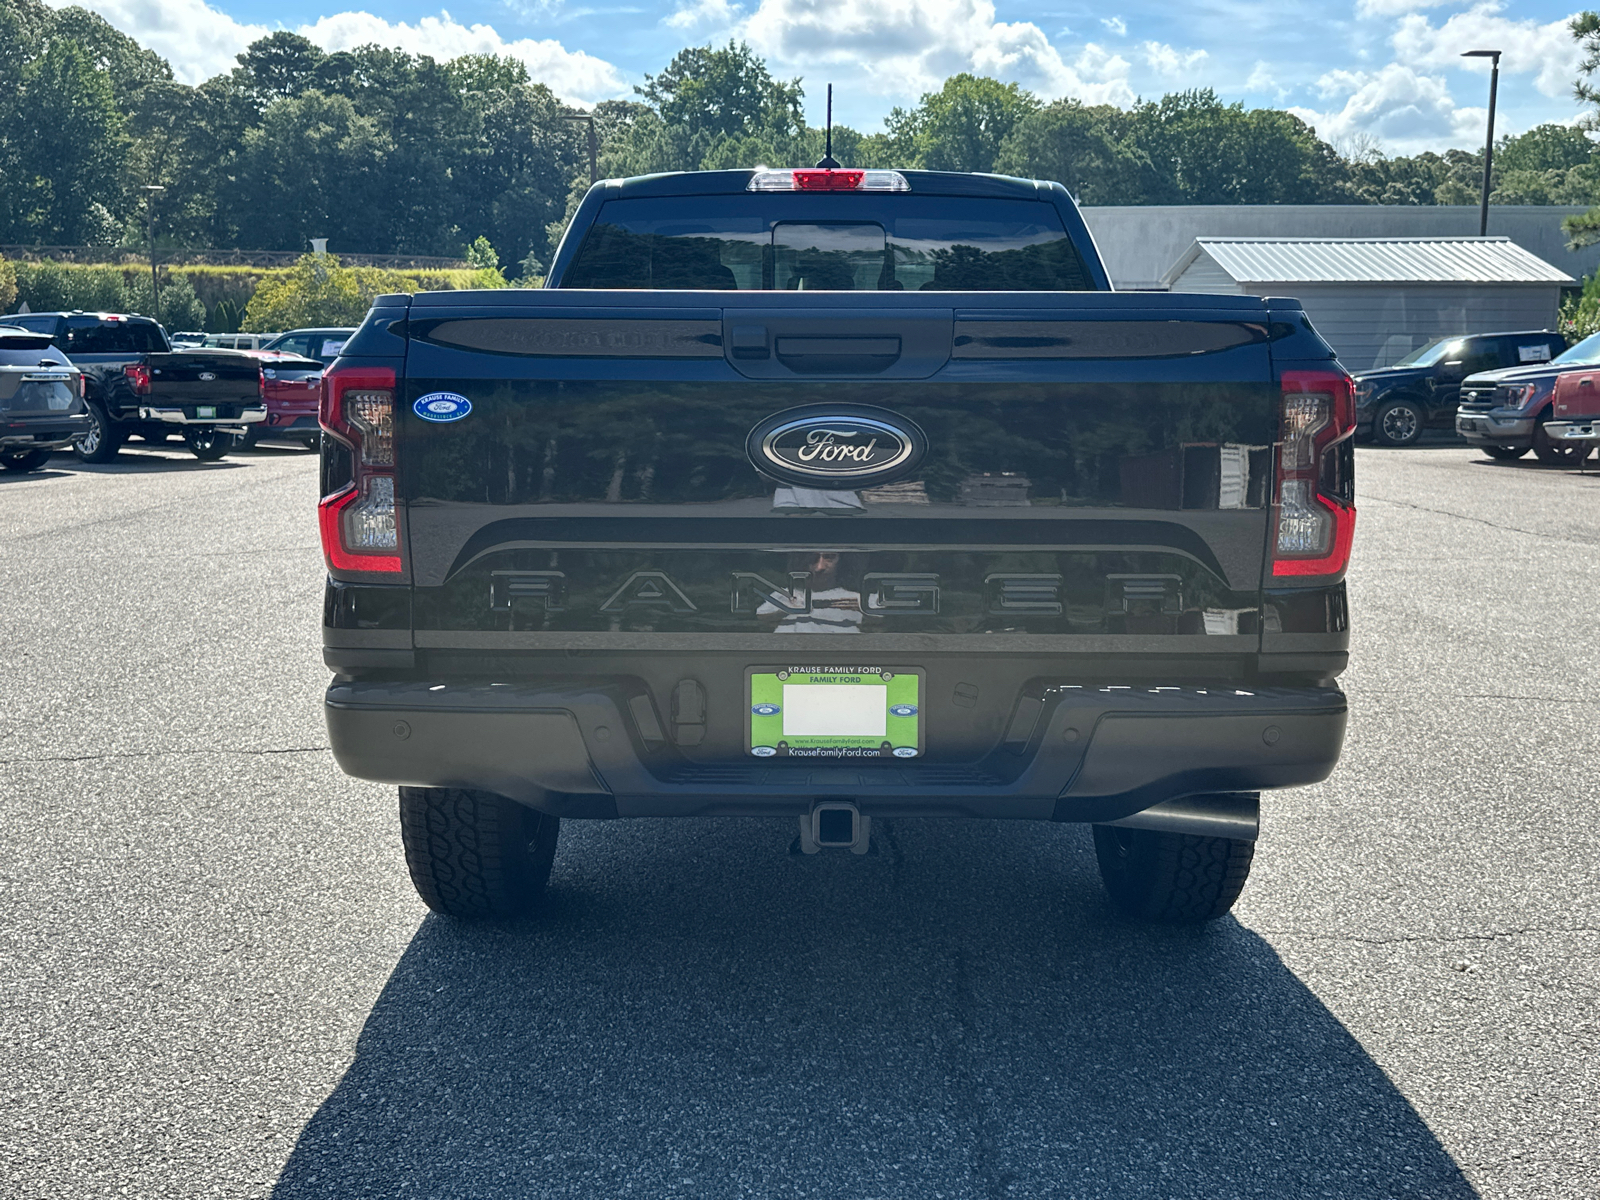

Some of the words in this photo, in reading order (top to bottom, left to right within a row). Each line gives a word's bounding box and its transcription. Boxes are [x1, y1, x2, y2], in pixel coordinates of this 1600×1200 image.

[421, 395, 442, 404] KRAUSE
[444, 395, 464, 403] FAMILY
[433, 402, 451, 410] Ford
[798, 429, 877, 461] Ford
[490, 570, 1183, 616] RANGER
[788, 666, 821, 674] KRAUSE
[824, 666, 854, 674] FAMILY
[788, 747, 881, 758] KrauseFamilyFord.com
